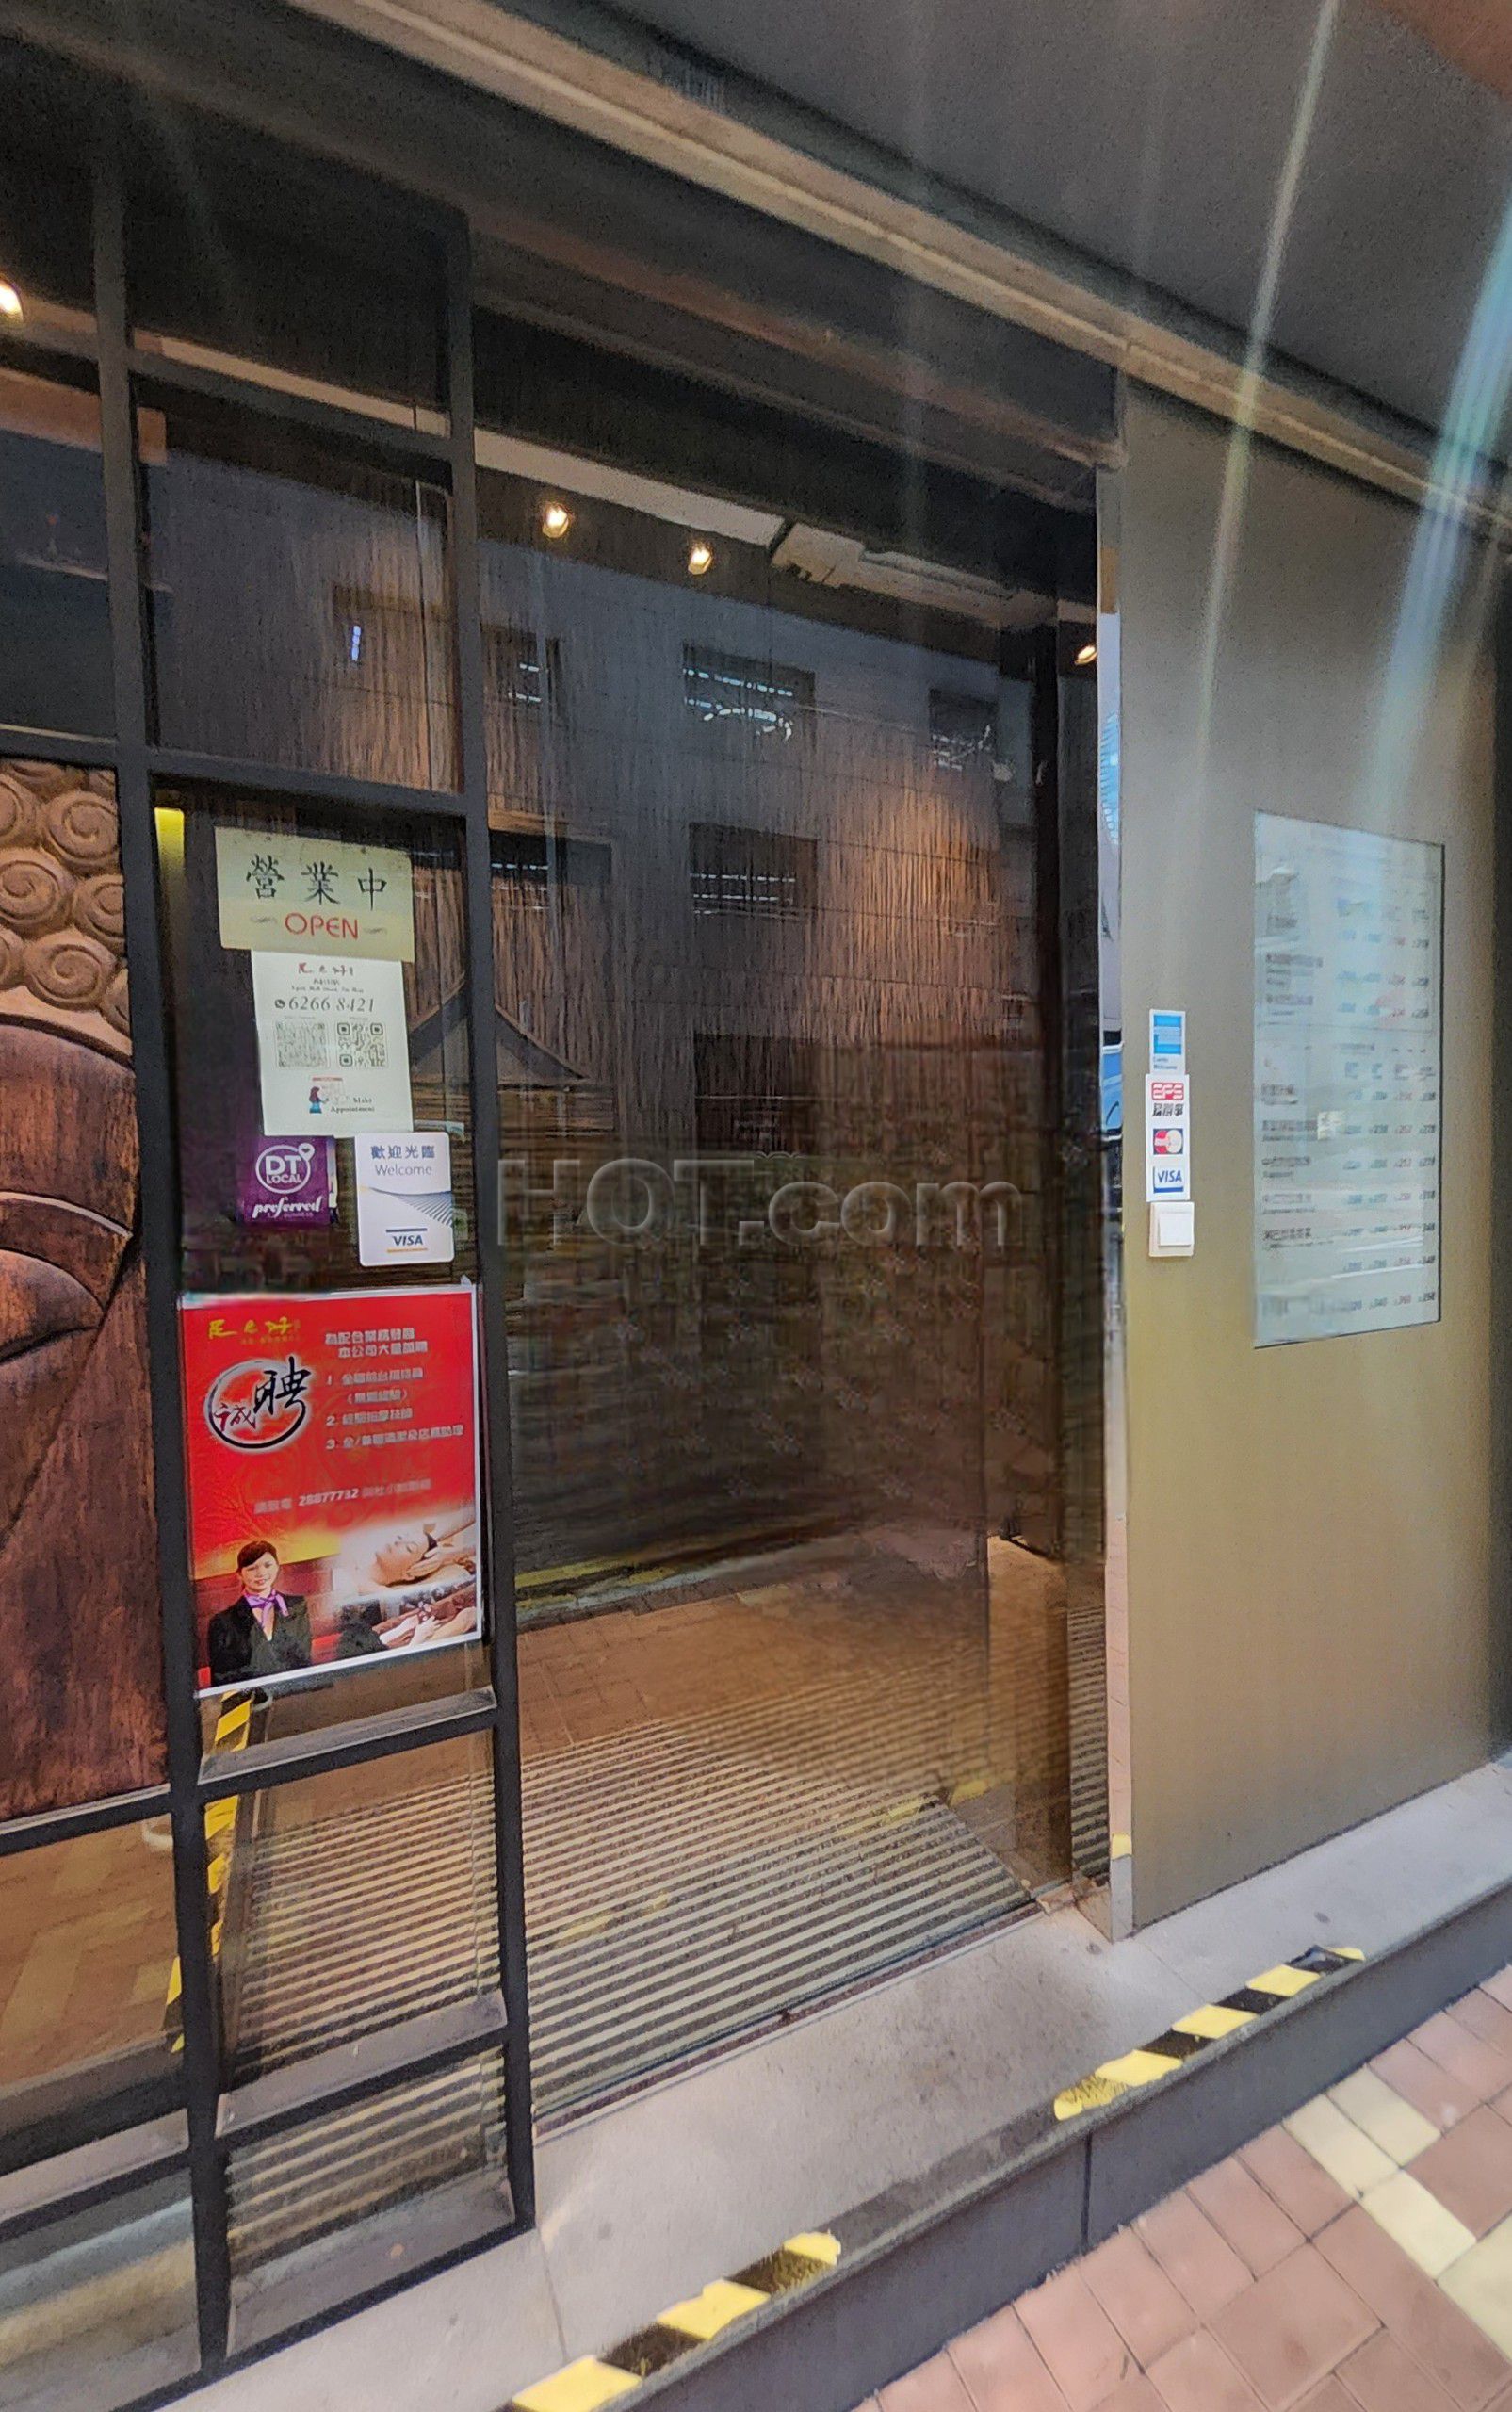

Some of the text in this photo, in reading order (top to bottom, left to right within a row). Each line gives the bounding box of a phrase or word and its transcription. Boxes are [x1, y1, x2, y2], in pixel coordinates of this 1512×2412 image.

[246, 854, 387, 910] 營業中
[285, 912, 358, 939] OPEN
[289, 996, 373, 1013] 6266 8421
[1152, 1083, 1184, 1100] EPS
[371, 1145, 435, 1159] 歡迎光臨
[265, 1155, 301, 1175] DT
[375, 1164, 432, 1176] Welcome
[266, 1173, 302, 1184] LOCAL
[1158, 1169, 1182, 1183] VISA
[252, 1195, 324, 1219] preferred
[392, 1234, 424, 1247] VISA
